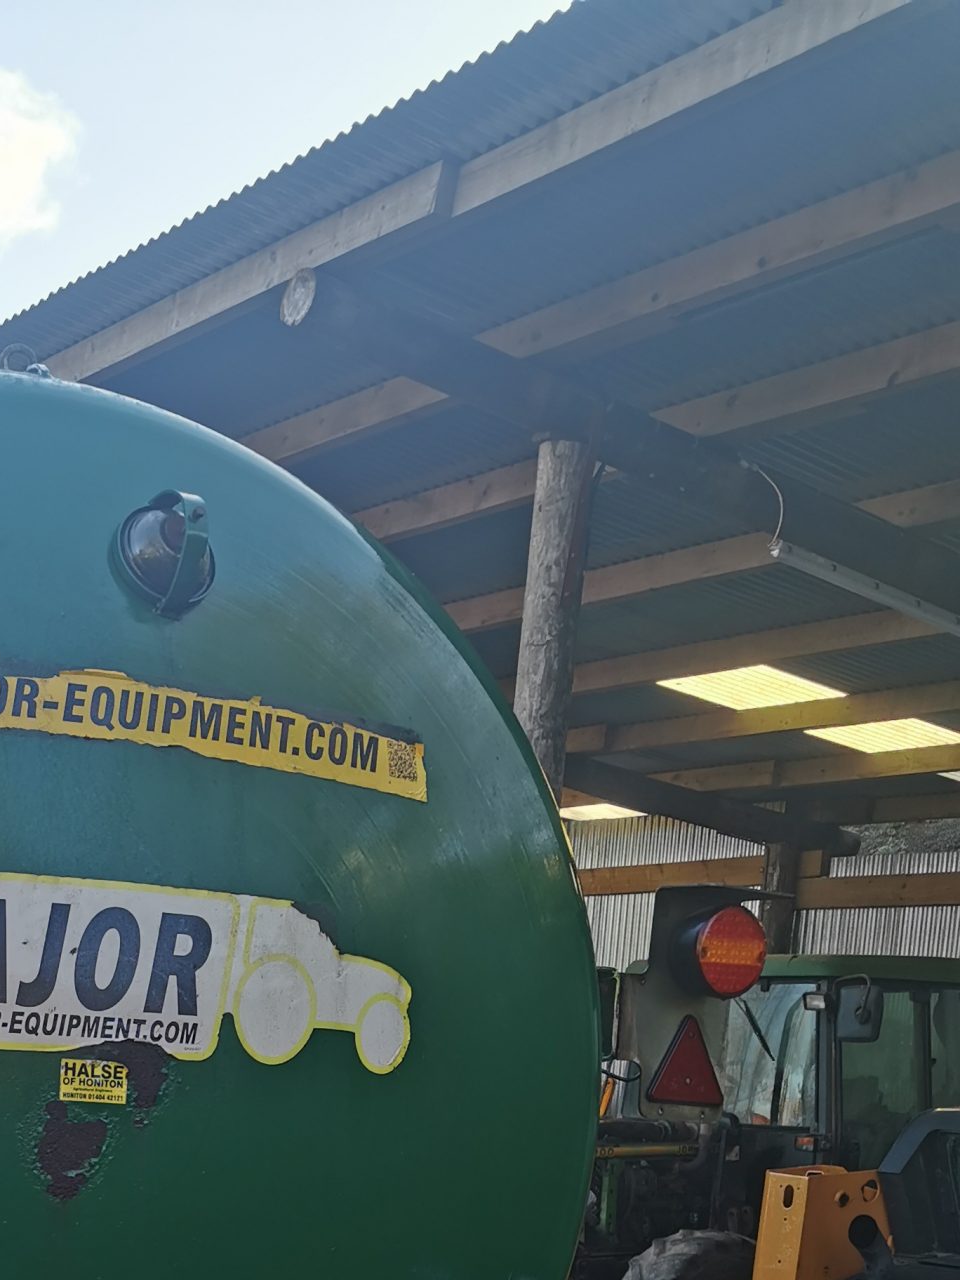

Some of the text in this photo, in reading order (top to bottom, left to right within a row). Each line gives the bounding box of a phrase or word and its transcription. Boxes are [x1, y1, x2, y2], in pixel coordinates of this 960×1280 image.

[64, 1062, 124, 1079] HALSE
[63, 1077, 123, 1088] OF HONITON
